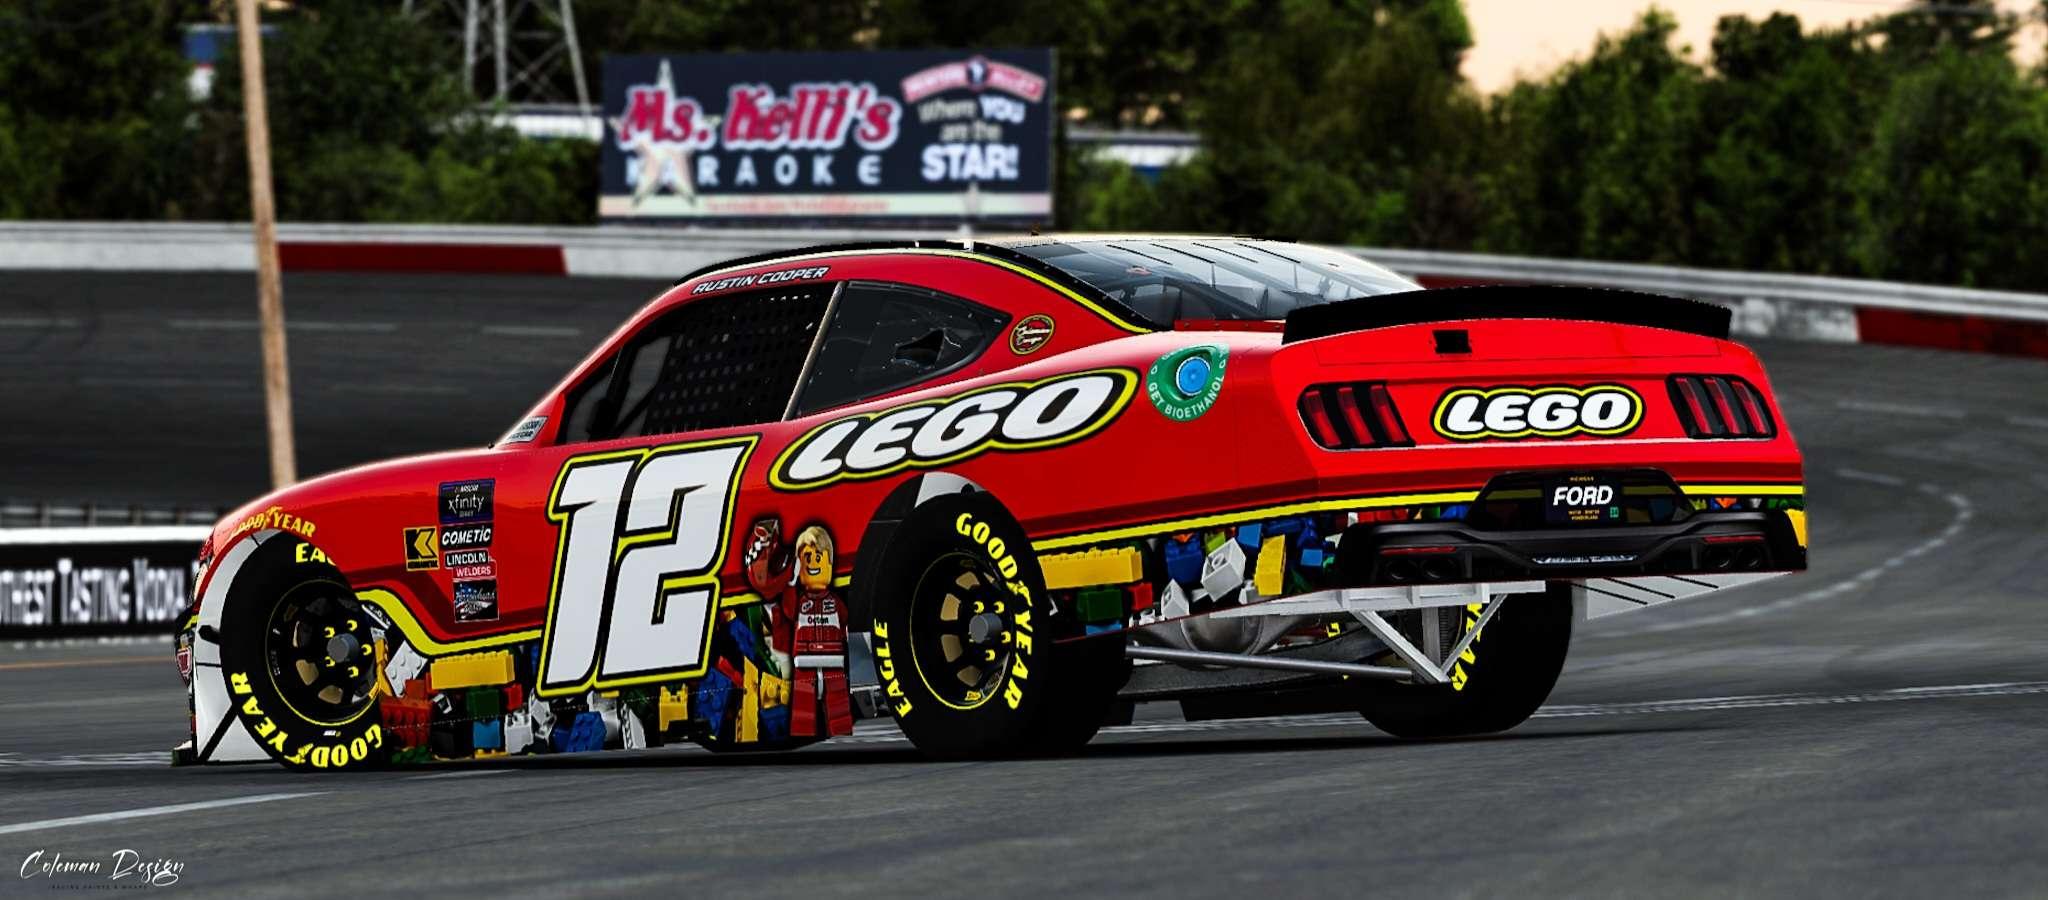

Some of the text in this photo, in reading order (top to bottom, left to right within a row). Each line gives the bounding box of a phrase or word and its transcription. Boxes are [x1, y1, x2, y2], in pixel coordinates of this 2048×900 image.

[619, 83, 901, 150] Ms. Kelli's
[980, 95, 1026, 124] YOU
[922, 143, 1019, 181] STAR!
[693, 267, 830, 294] AUSTIN COOPER
[1148, 375, 1225, 419] GET BIOETHANOL
[1446, 392, 1631, 432] LEGO
[788, 376, 1114, 482] LEGO
[448, 494, 485, 514] xfinity
[1553, 485, 1613, 506] FORD
[230, 505, 317, 538] OODYEAR
[442, 525, 491, 546] COMETIC
[295, 542, 336, 566] EA
[446, 551, 487, 567] LINCOLN
[544, 444, 748, 684] 12
[456, 566, 492, 578] WELDERS
[955, 512, 1034, 709] GOODYEAR
[873, 617, 914, 718] EAGLE
[230, 671, 382, 769] GOODYEAR
